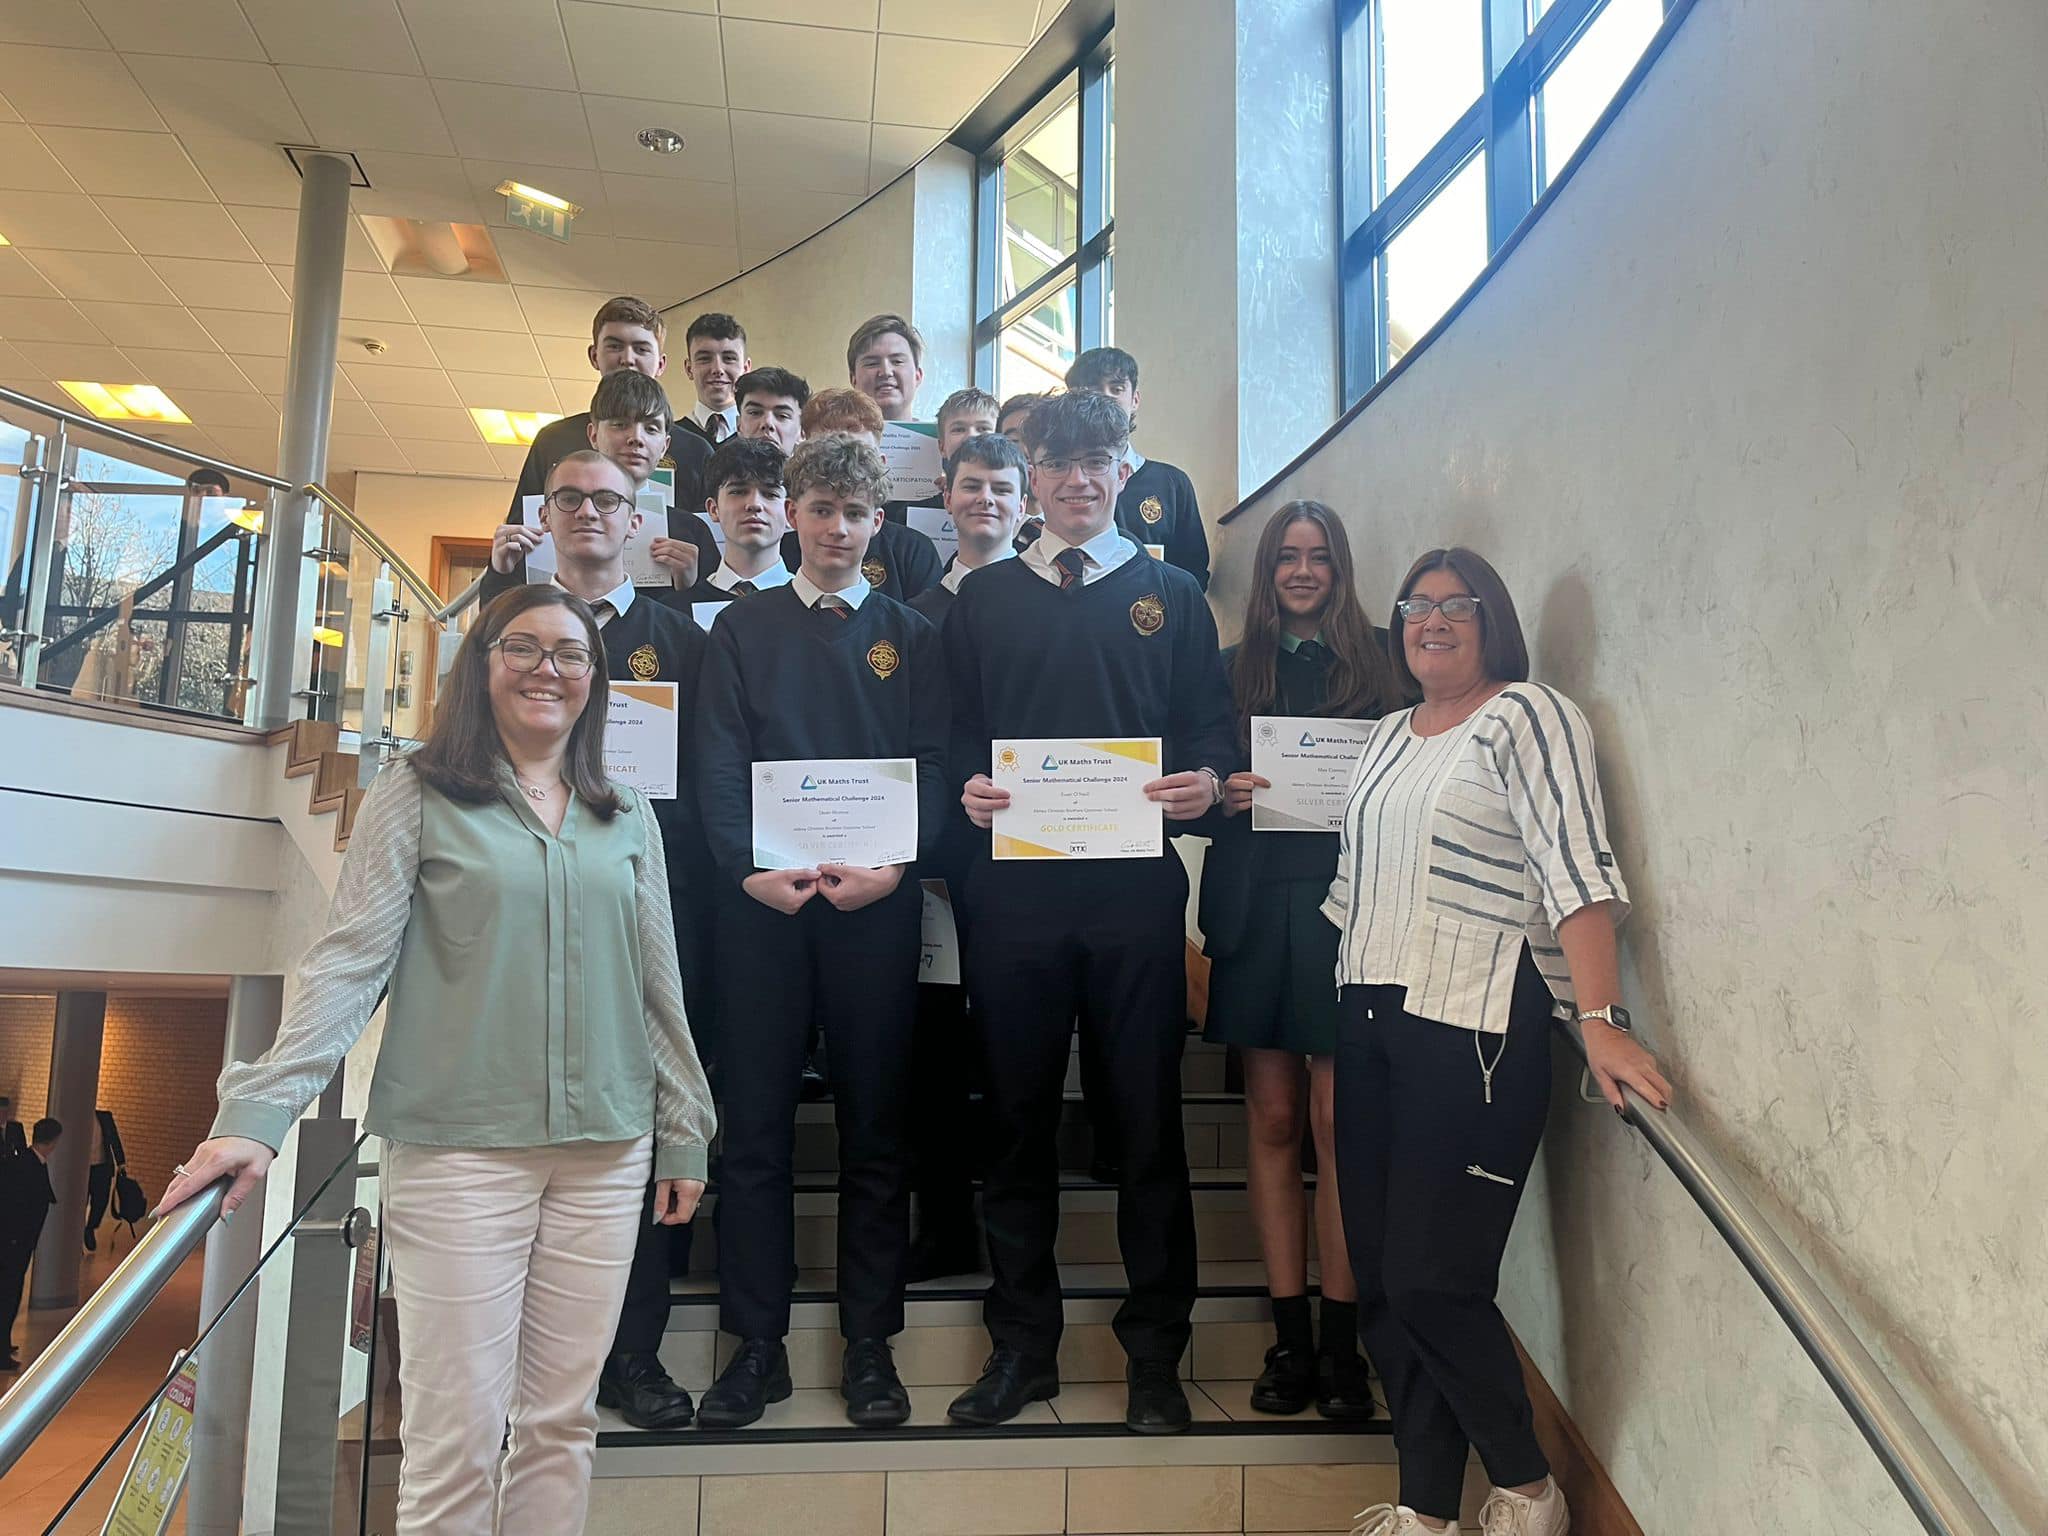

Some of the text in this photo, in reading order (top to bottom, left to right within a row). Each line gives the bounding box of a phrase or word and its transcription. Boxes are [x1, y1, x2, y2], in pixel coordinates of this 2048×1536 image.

[1070, 758, 1092, 766] Maths
[609, 765, 637, 773] FICATE
[851, 777, 869, 785] Trust
[1083, 776, 1111, 784] Challenge
[802, 795, 841, 803] Mathematical
[1040, 824, 1118, 833] GOLD CERTIFICATE
